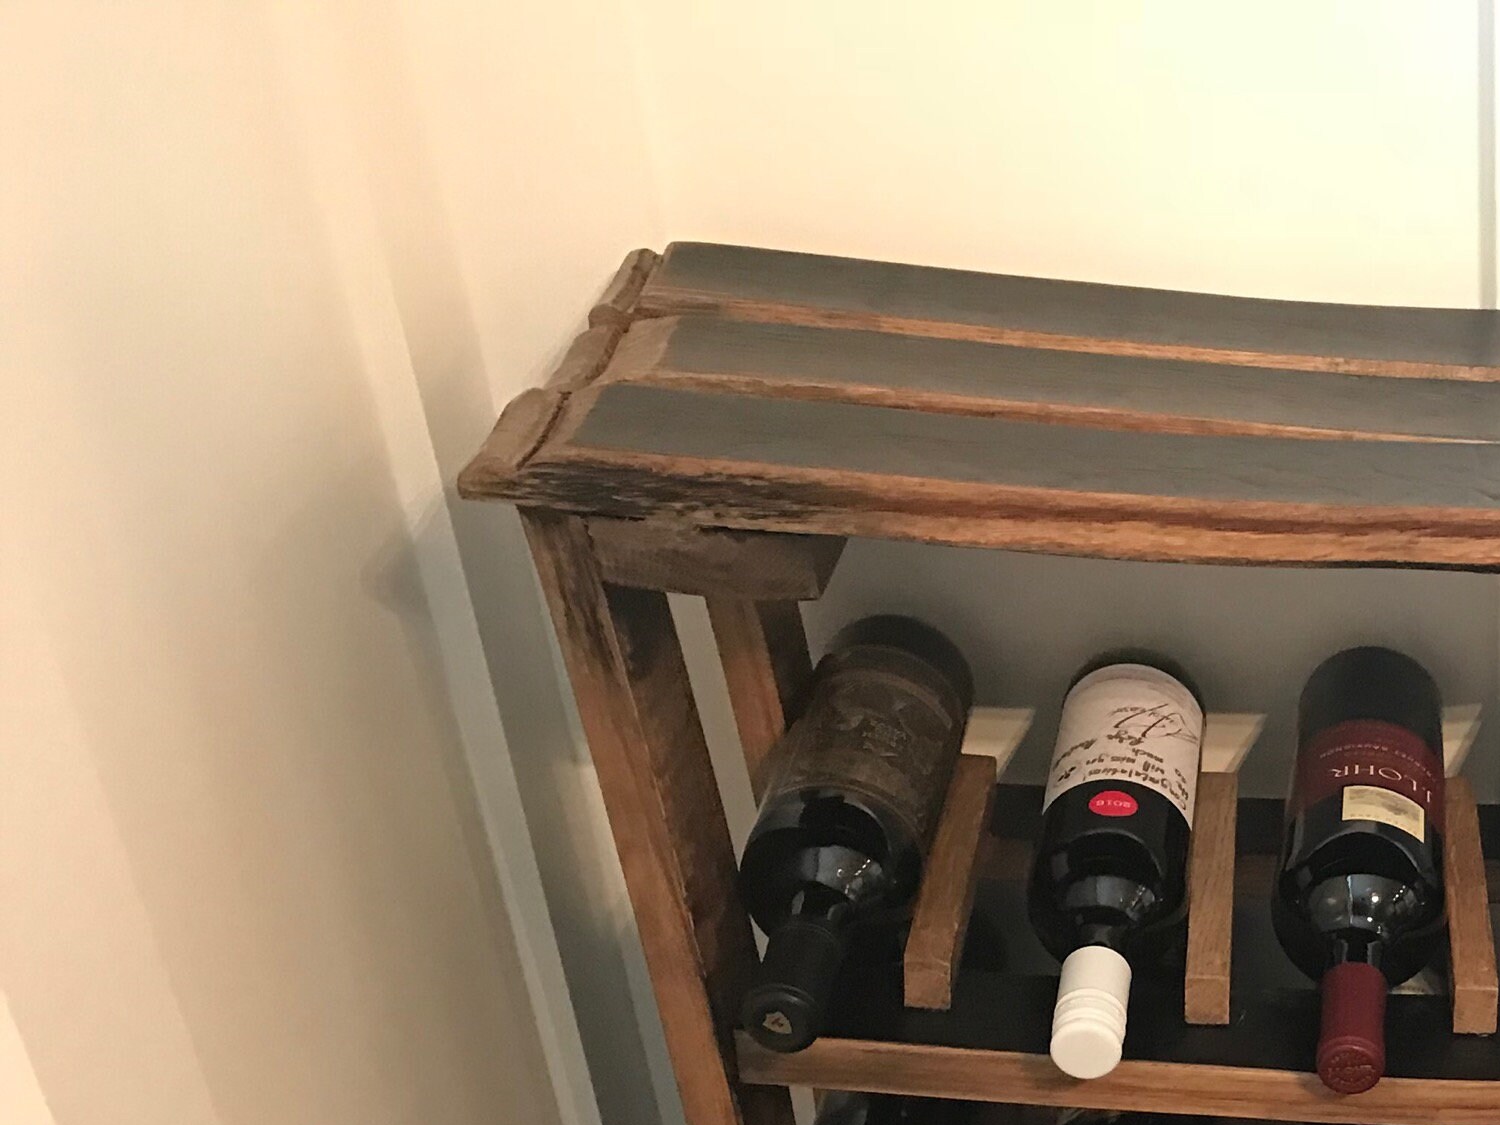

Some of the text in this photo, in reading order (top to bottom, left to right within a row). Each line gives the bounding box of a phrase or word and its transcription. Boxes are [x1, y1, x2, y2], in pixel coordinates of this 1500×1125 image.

[1086, 753, 1109, 766] you
[1131, 748, 1164, 764] much
[1142, 761, 1166, 775] will
[1329, 763, 1417, 792] LOHR
[1095, 799, 1132, 809] 2016
